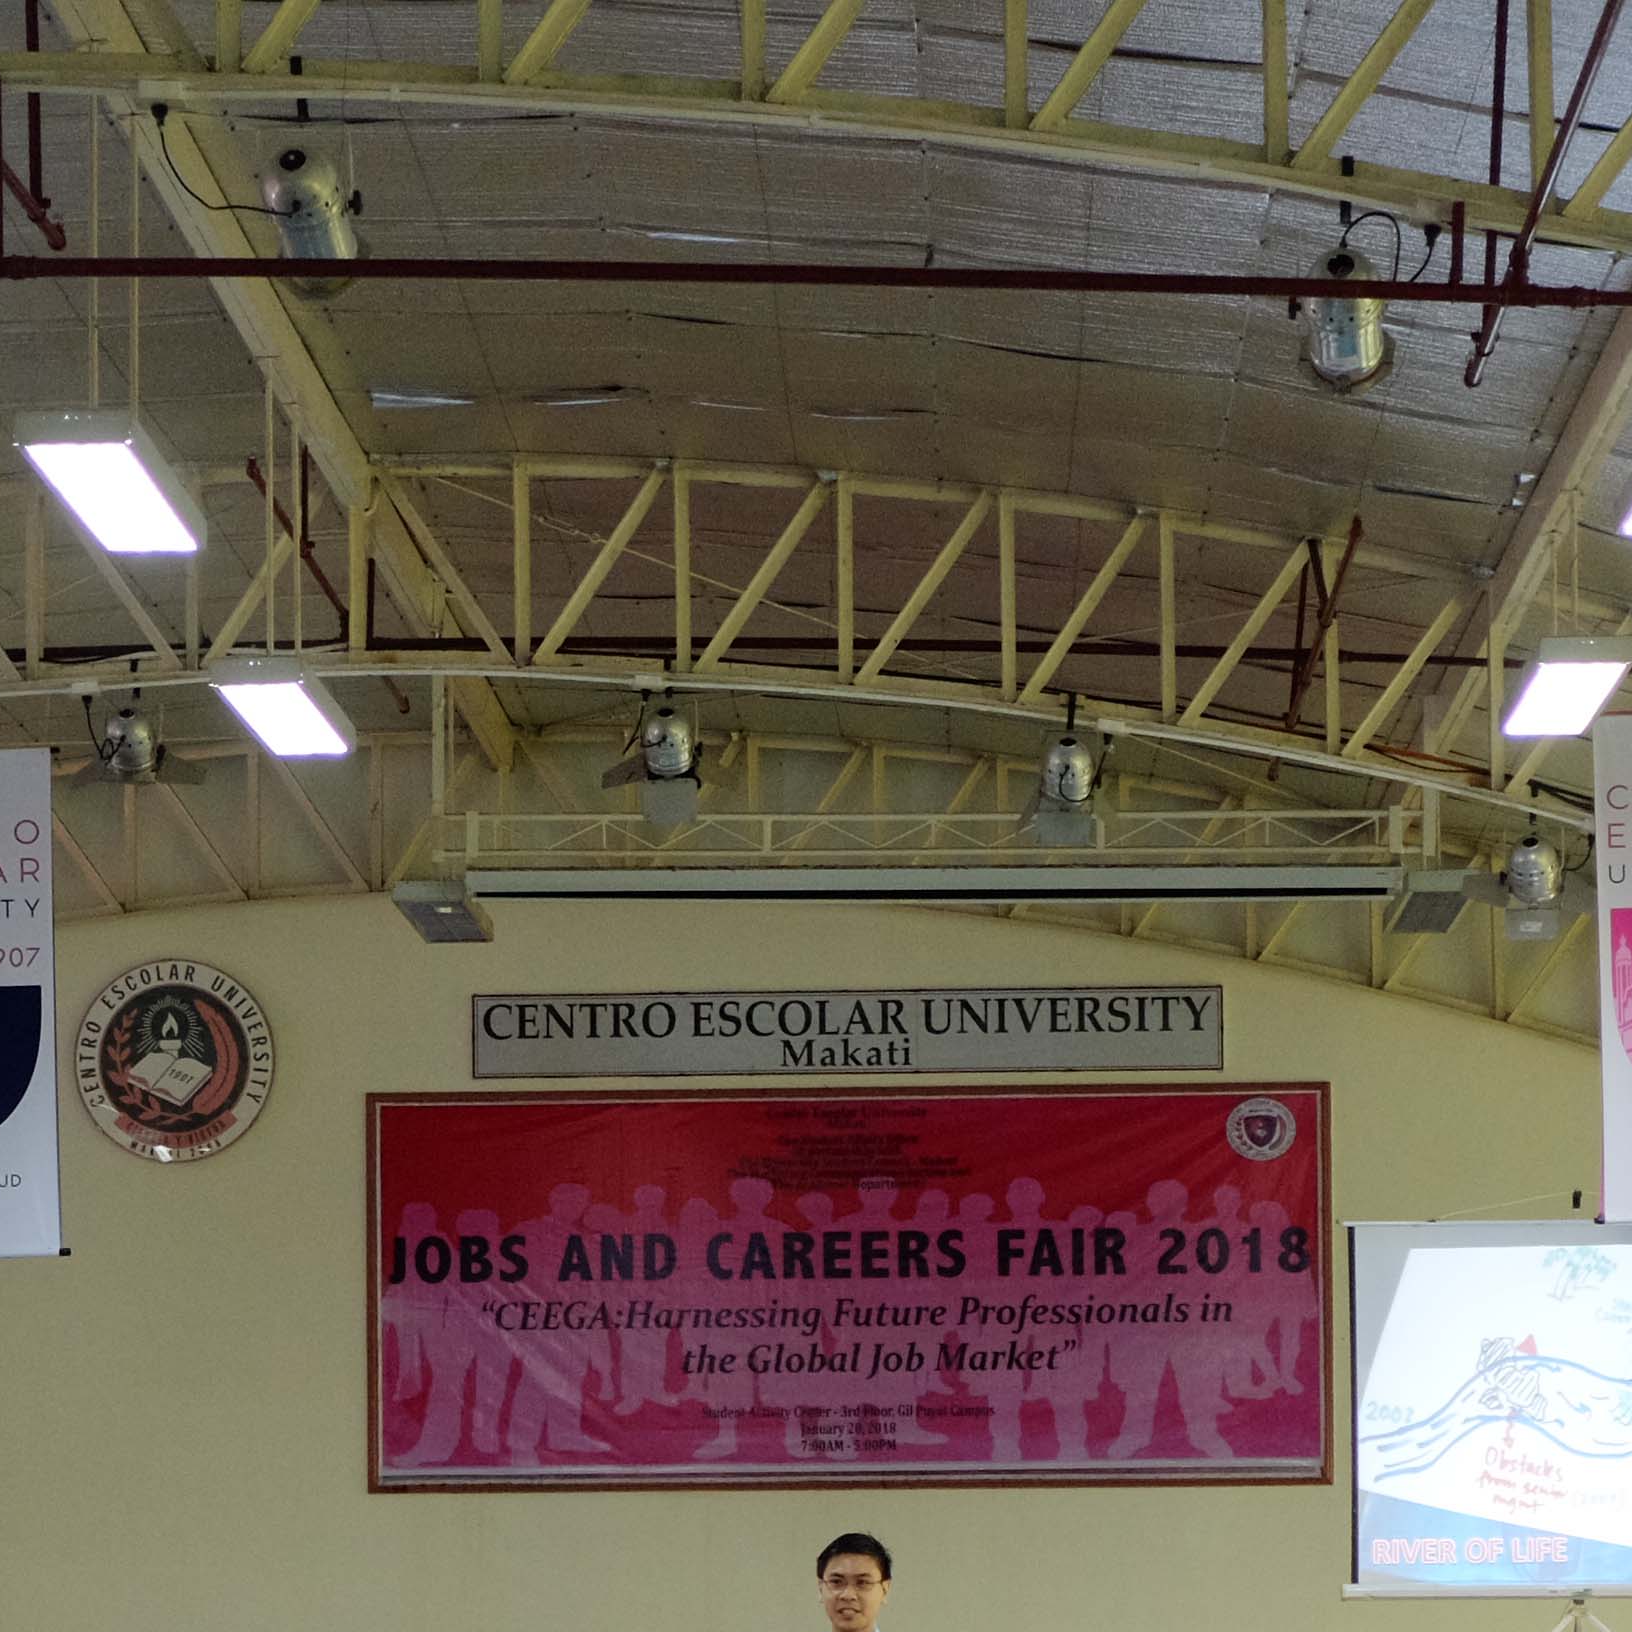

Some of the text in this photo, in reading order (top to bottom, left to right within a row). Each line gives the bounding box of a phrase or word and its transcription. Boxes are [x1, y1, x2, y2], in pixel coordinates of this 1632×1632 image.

[79, 963, 270, 1108] CENTRO ESCOLAR UNIVERSITY
[482, 994, 1211, 1041] CENTRO ESCOLAR UNIVERSITY
[779, 1036, 914, 1068] Makati
[389, 1225, 1312, 1285] JOBS AND CAREERS FAIR 2018
[832, 1296, 948, 1329] Future
[956, 1292, 1190, 1335] Professionals
[1199, 1292, 1234, 1323] in
[681, 1338, 1078, 1381] the Global Job Market”
[800, 1422, 846, 1438] January
[867, 1421, 897, 1435] 2018
[840, 1405, 861, 1418] 3rd
[897, 1404, 914, 1418] Gil
[1372, 1536, 1570, 1565] RIVER OF LIFE
